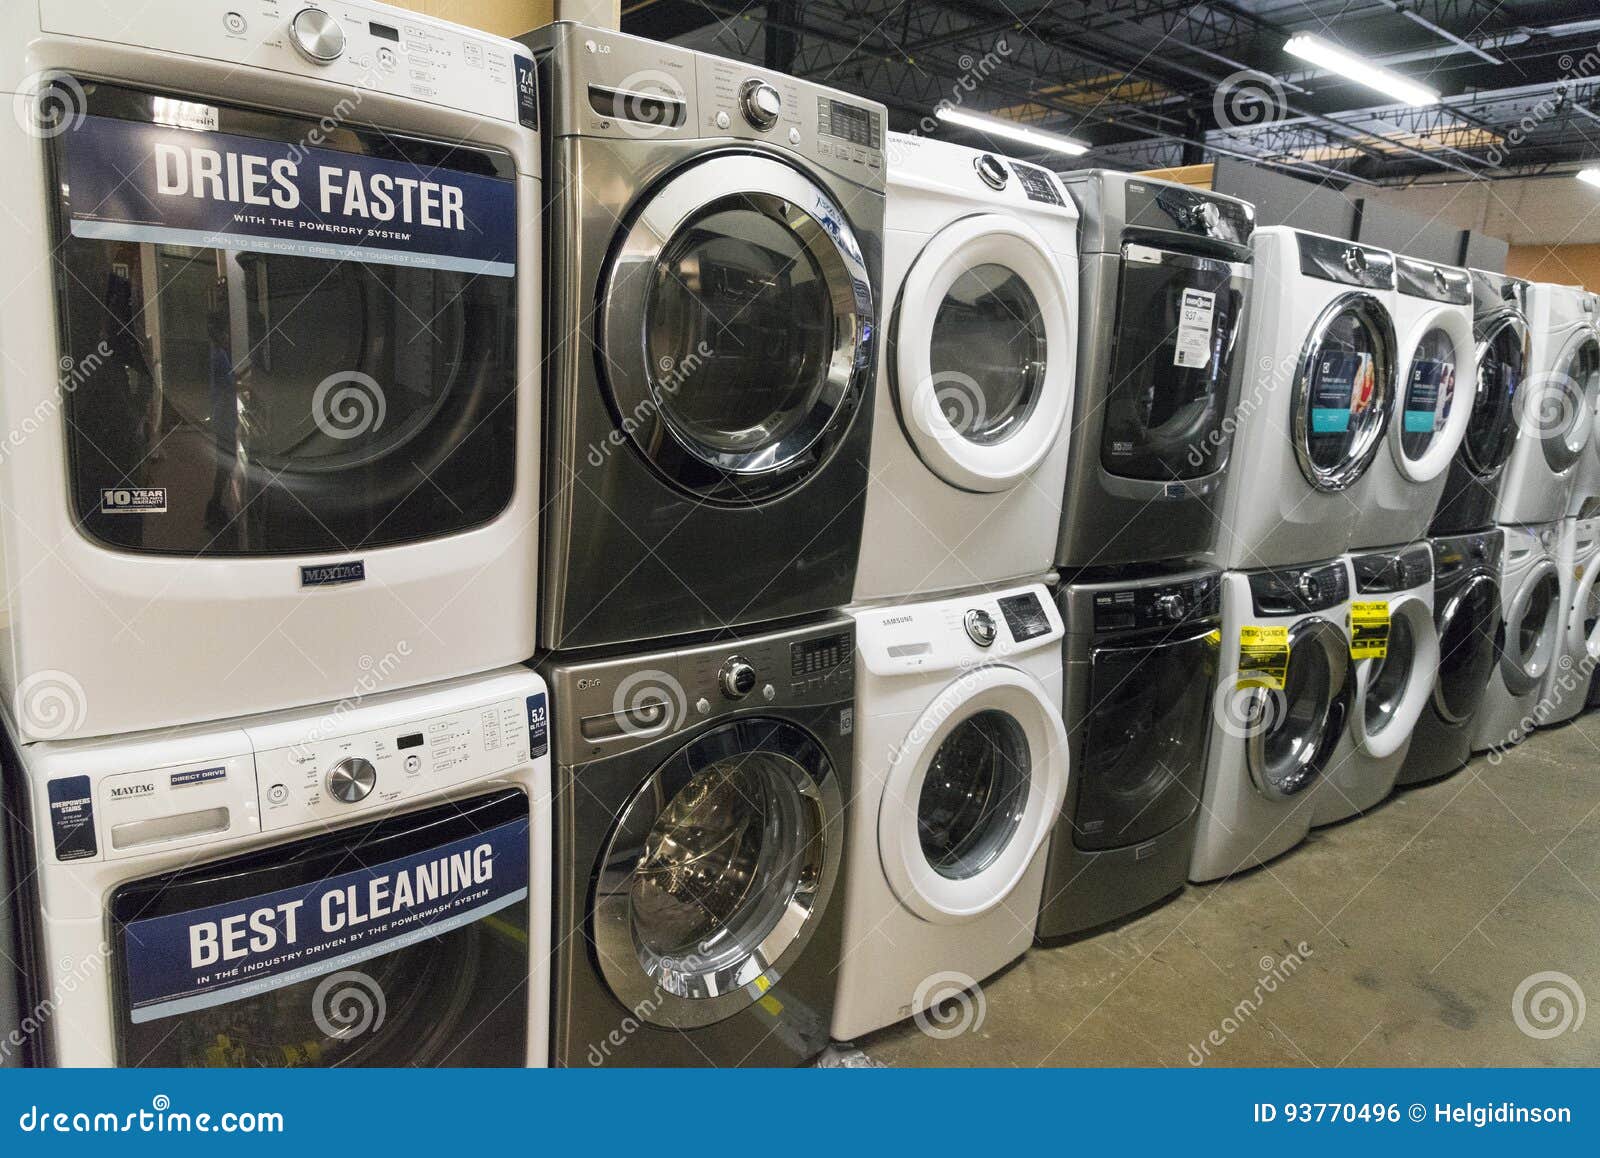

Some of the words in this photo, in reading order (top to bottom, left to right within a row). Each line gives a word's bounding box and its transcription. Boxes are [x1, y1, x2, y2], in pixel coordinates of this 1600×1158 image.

[519, 67, 533, 88] 7.4
[155, 143, 300, 209] DRIES
[319, 165, 465, 231] FASTER
[233, 213, 265, 225] WITH
[270, 217, 294, 228] THE
[299, 221, 363, 236] POWERDRY
[367, 229, 411, 241] SYSTEM
[203, 235, 232, 246] OPEN
[235, 238, 248, 248] TO
[253, 239, 271, 249] SEE
[273, 242, 296, 252] HOW
[298, 245, 306, 253] IT
[339, 248, 363, 258] YOUR
[104, 490, 130, 505] 10
[303, 564, 362, 581] MAYTAG
[883, 615, 913, 626] SAMSUNG
[531, 706, 545, 723] 5.2
[171, 773, 200, 783] DIRECT
[202, 769, 225, 779] DRIVE
[111, 783, 154, 797] MAYTAG
[188, 899, 303, 968] BEST
[320, 843, 493, 933] CLEANING
[196, 974, 210, 985] IN
[215, 968, 239, 980] THE
[243, 950, 302, 973] INDUSTRY
[306, 937, 347, 955] DRIVEN
[350, 932, 364, 942] BY
[368, 924, 388, 936] THE
[391, 904, 451, 928] POWERWASH
[454, 889, 489, 907] SYSTEM
[241, 981, 268, 994] OPEN
[270, 977, 282, 987] TO
[303, 965, 325, 977] HOW
[326, 962, 333, 971] IT
